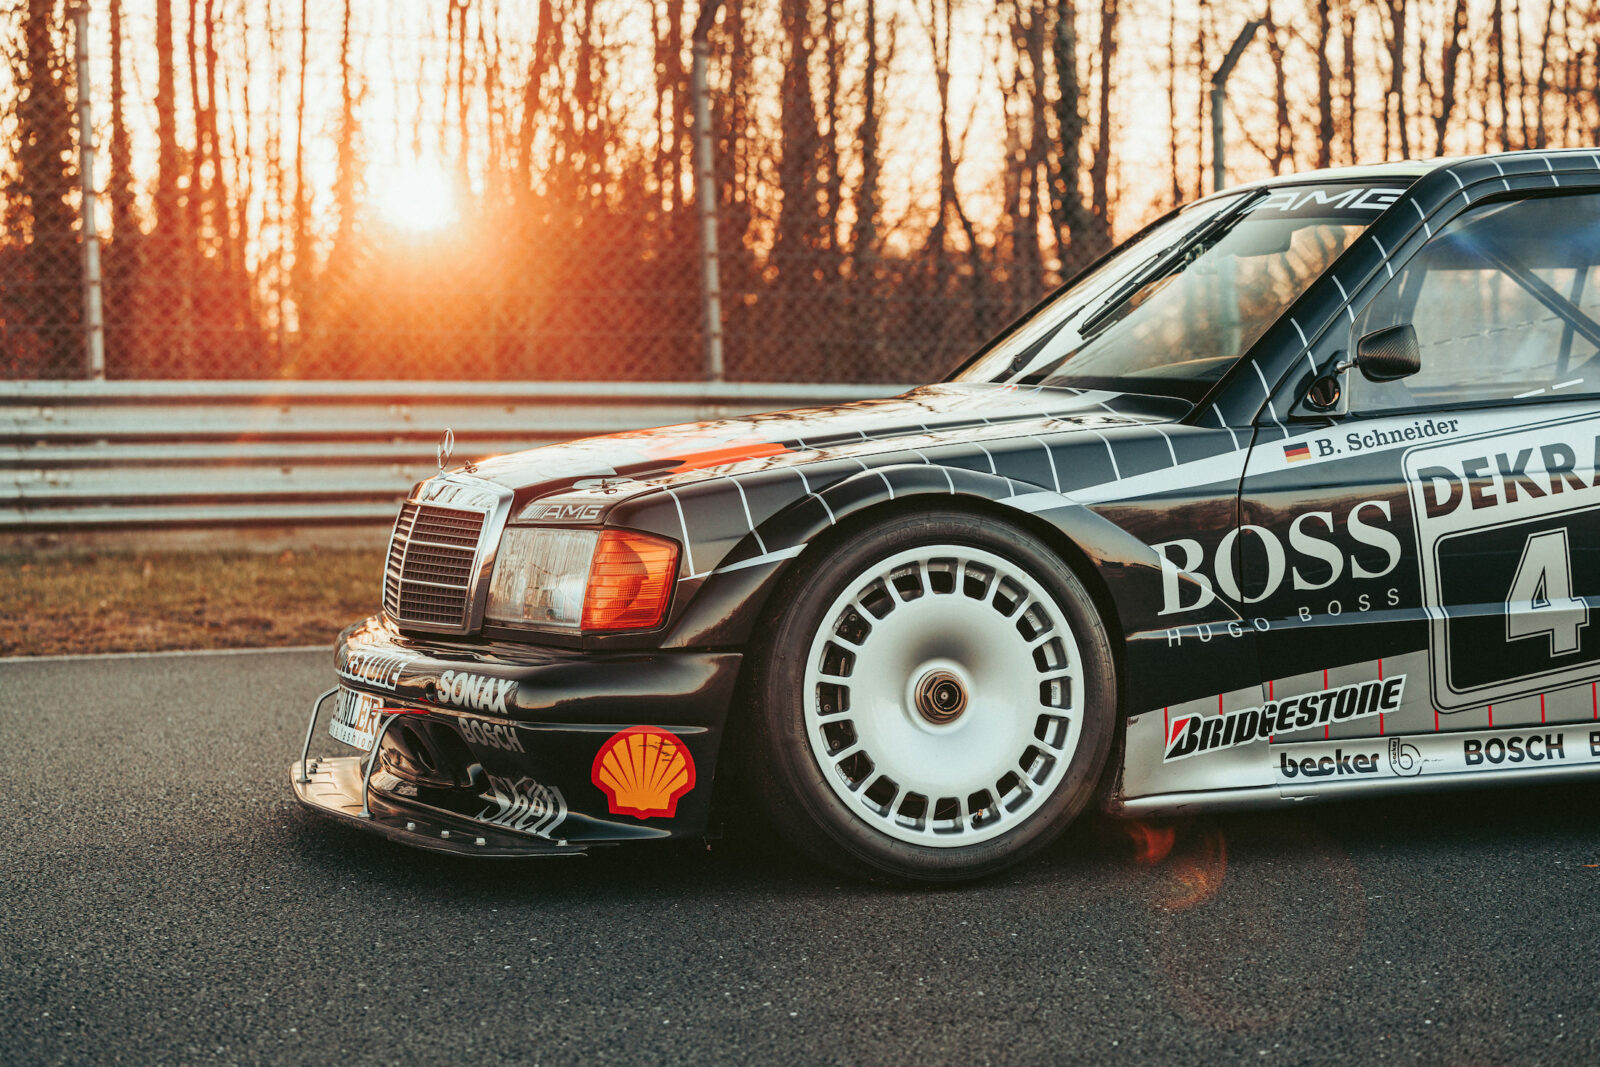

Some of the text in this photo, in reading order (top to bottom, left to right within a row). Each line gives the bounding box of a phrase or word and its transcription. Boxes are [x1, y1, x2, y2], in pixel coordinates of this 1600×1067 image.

[1253, 188, 1407, 212] AMG
[1315, 418, 1460, 457] B. Schneider
[1416, 435, 1600, 519] DEKR
[541, 504, 605, 520] AMG
[1151, 500, 1402, 616] BOSS
[1506, 526, 1590, 658] 4
[1167, 588, 1401, 648] HUGO BOSS
[437, 669, 516, 714] SONAX
[458, 716, 527, 754] BOSCH
[1164, 674, 1407, 763] BRIDGESTONE
[1279, 750, 1380, 777] becker
[1463, 733, 1565, 765] BOSCH
